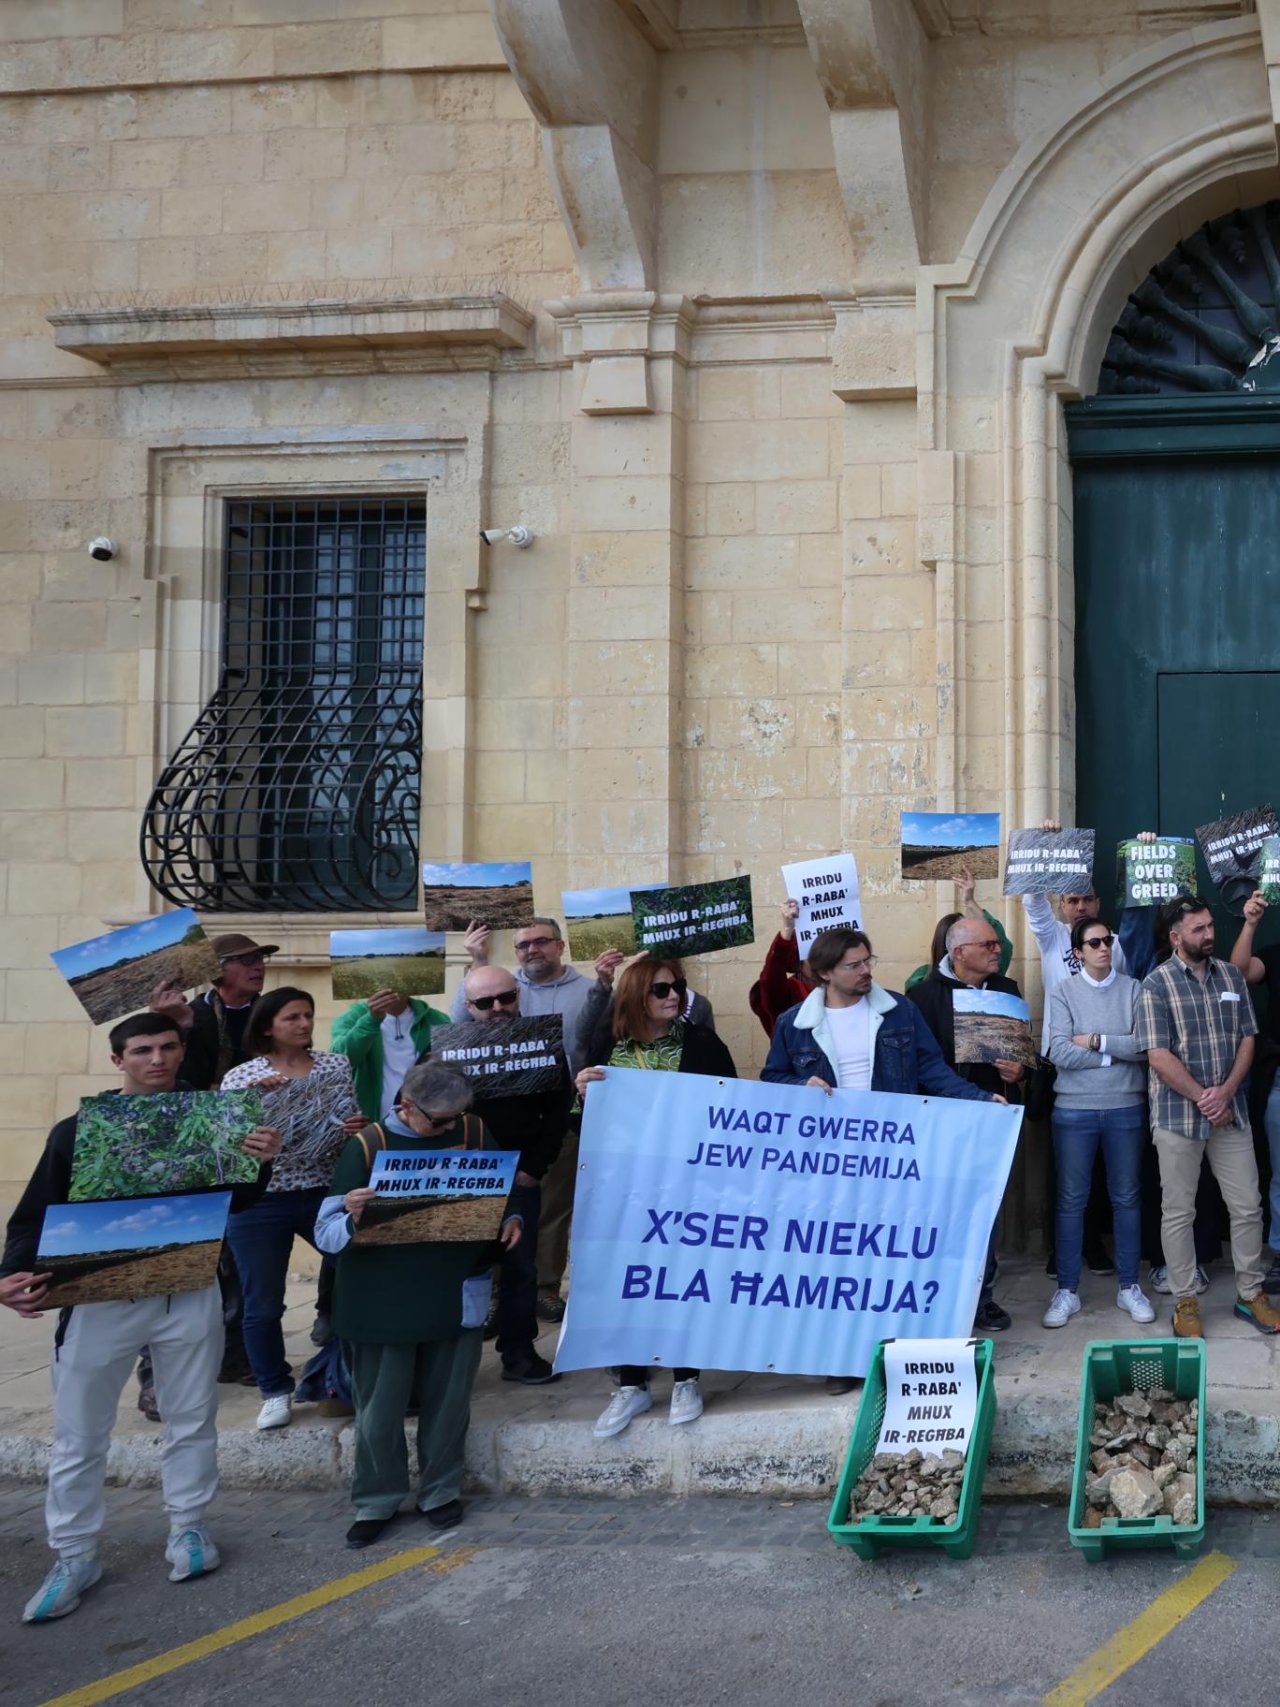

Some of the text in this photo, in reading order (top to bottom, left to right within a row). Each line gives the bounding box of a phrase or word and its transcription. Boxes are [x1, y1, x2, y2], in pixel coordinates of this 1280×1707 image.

[1207, 834, 1237, 851] IRRIDU
[1011, 849, 1041, 860] IRRIDU
[1131, 845, 1176, 861] FIELDS
[1007, 863, 1033, 874] MHUX
[1135, 863, 1174, 880] OVER
[802, 872, 842, 889] IRRIDU
[801, 888, 849, 907] R-RABA'
[1131, 882, 1178, 899] GREED
[643, 900, 741, 927] IRRIDU R-RABA'
[810, 905, 844, 922] MHUX
[643, 928, 682, 945] MHUX
[441, 1039, 549, 1062] IRRIDU R-RABA'
[708, 1105, 916, 1147] WAQT GWERRA
[385, 1157, 504, 1171] IRRIDU R-RABA'
[686, 1141, 921, 1182] JEW PANDEMIJA
[373, 1178, 421, 1192] MHUX
[640, 1208, 938, 1260] X'SER NIEKLU
[621, 1264, 940, 1314] BLA ĦAMRIJA?
[904, 1362, 956, 1375] IRRIDU
[901, 1381, 962, 1397] R-RABA'
[906, 1404, 953, 1421] MHUX
